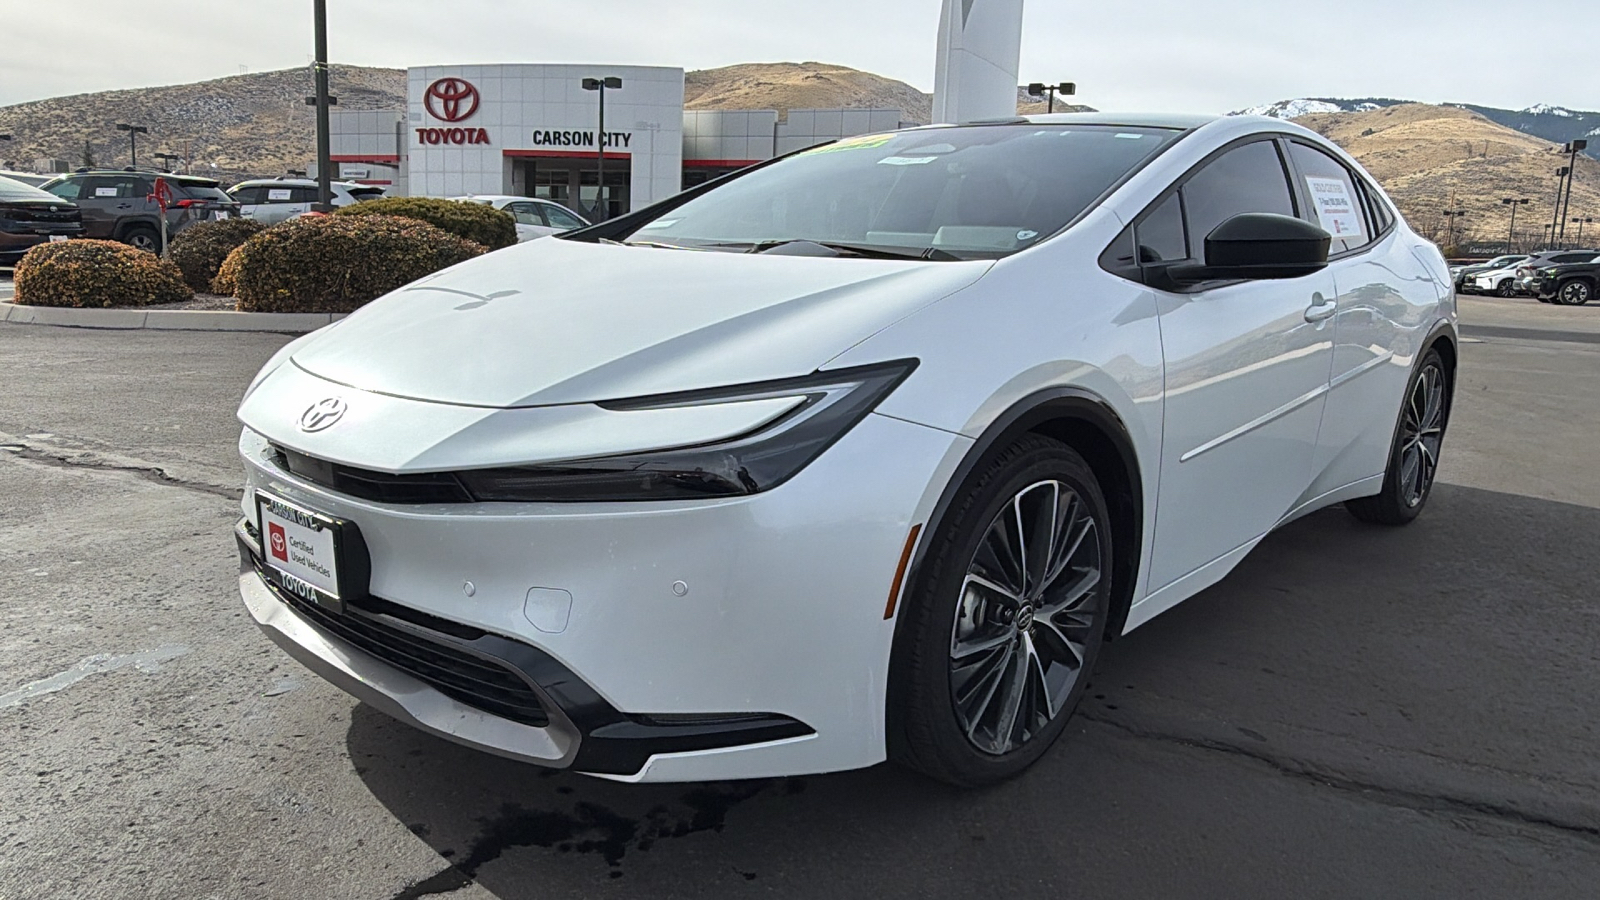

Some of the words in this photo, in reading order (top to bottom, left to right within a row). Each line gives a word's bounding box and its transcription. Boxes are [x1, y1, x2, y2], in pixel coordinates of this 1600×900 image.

[415, 127, 490, 145] TOYOTA
[532, 130, 594, 147] CARSON
[598, 131, 632, 148] CITY
[289, 536, 314, 556] Certified
[291, 550, 306, 566] Used
[306, 557, 331, 578] Vehicles
[280, 572, 319, 604] TOYOTA
